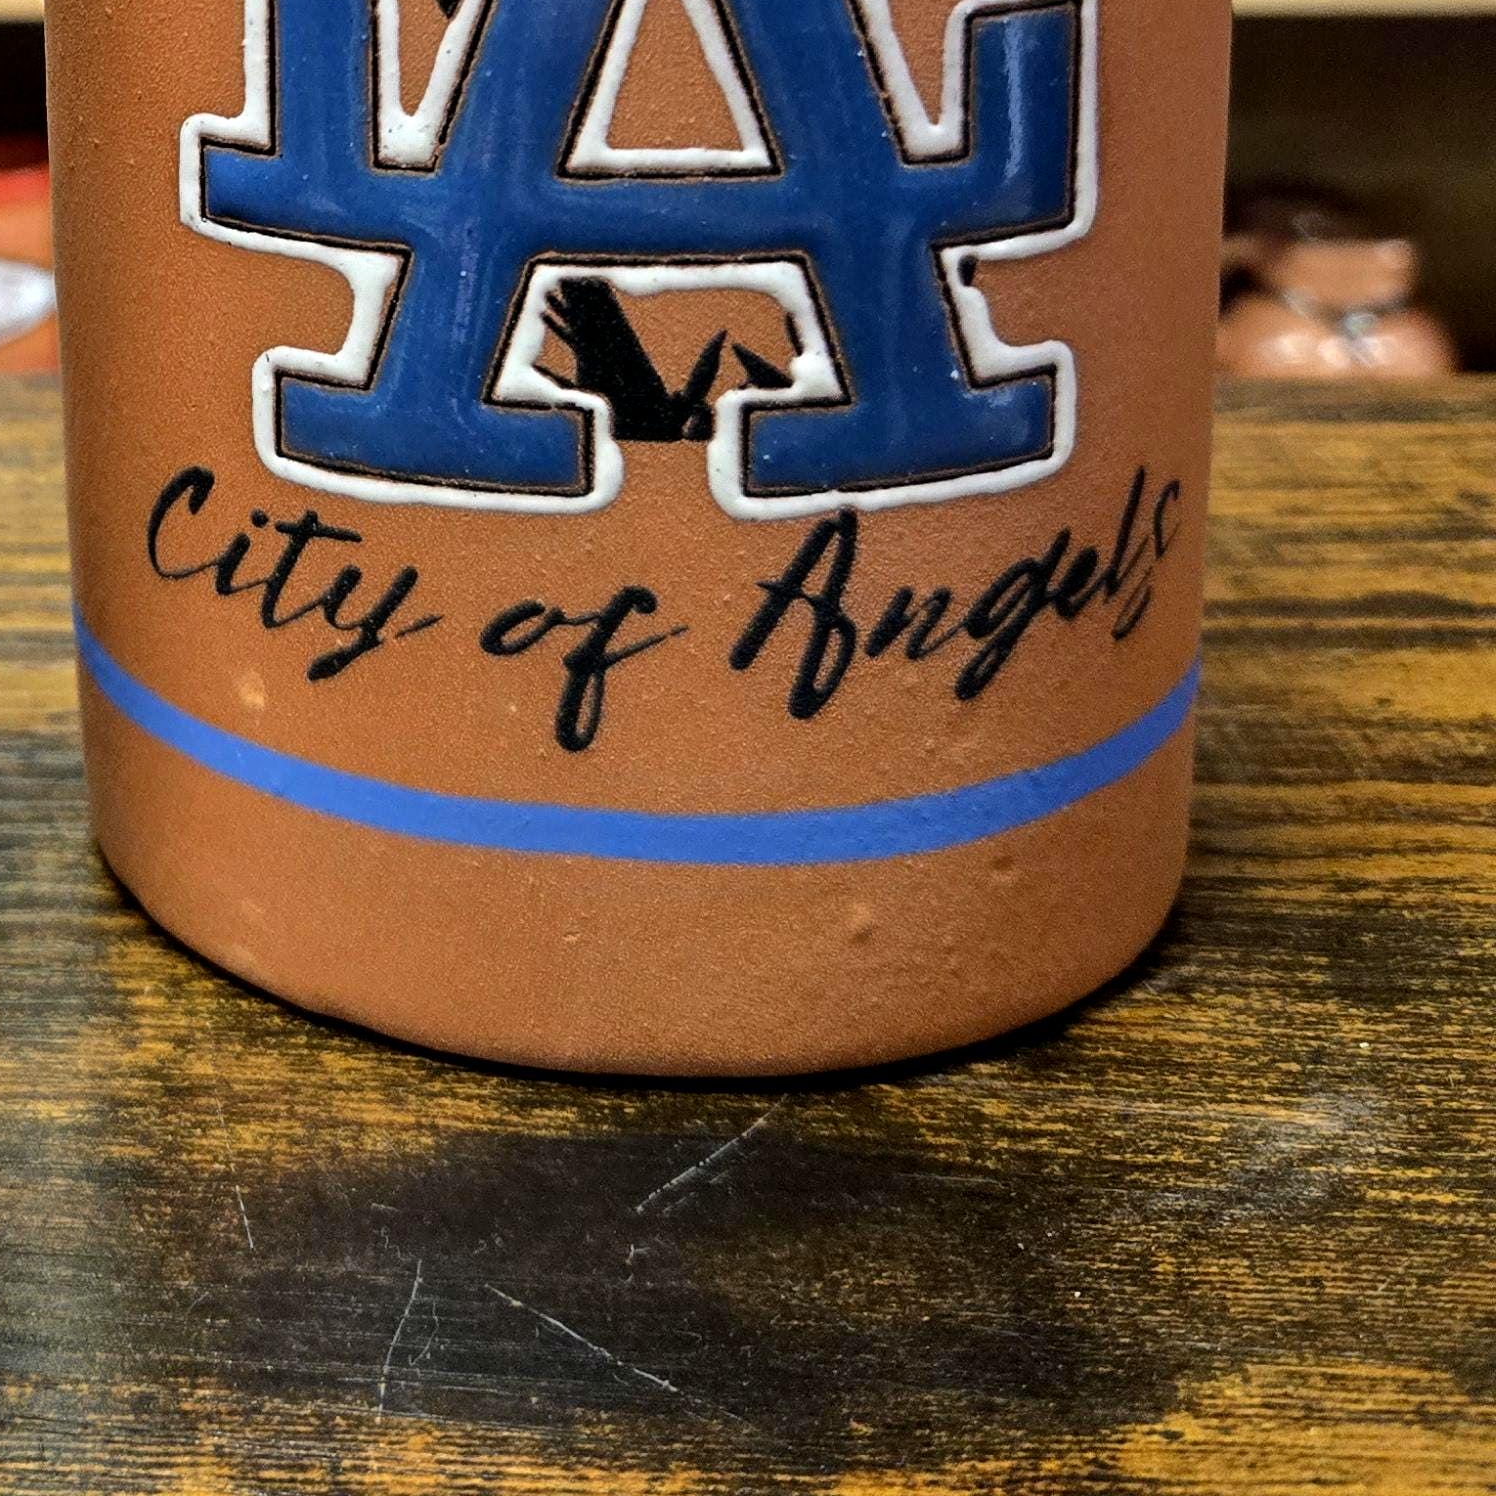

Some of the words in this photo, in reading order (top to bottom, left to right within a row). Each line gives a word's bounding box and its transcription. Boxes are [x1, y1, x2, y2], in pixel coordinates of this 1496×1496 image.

[148, 466, 443, 682] City
[480, 585, 689, 753] of
[729, 465, 1180, 719] Angels
